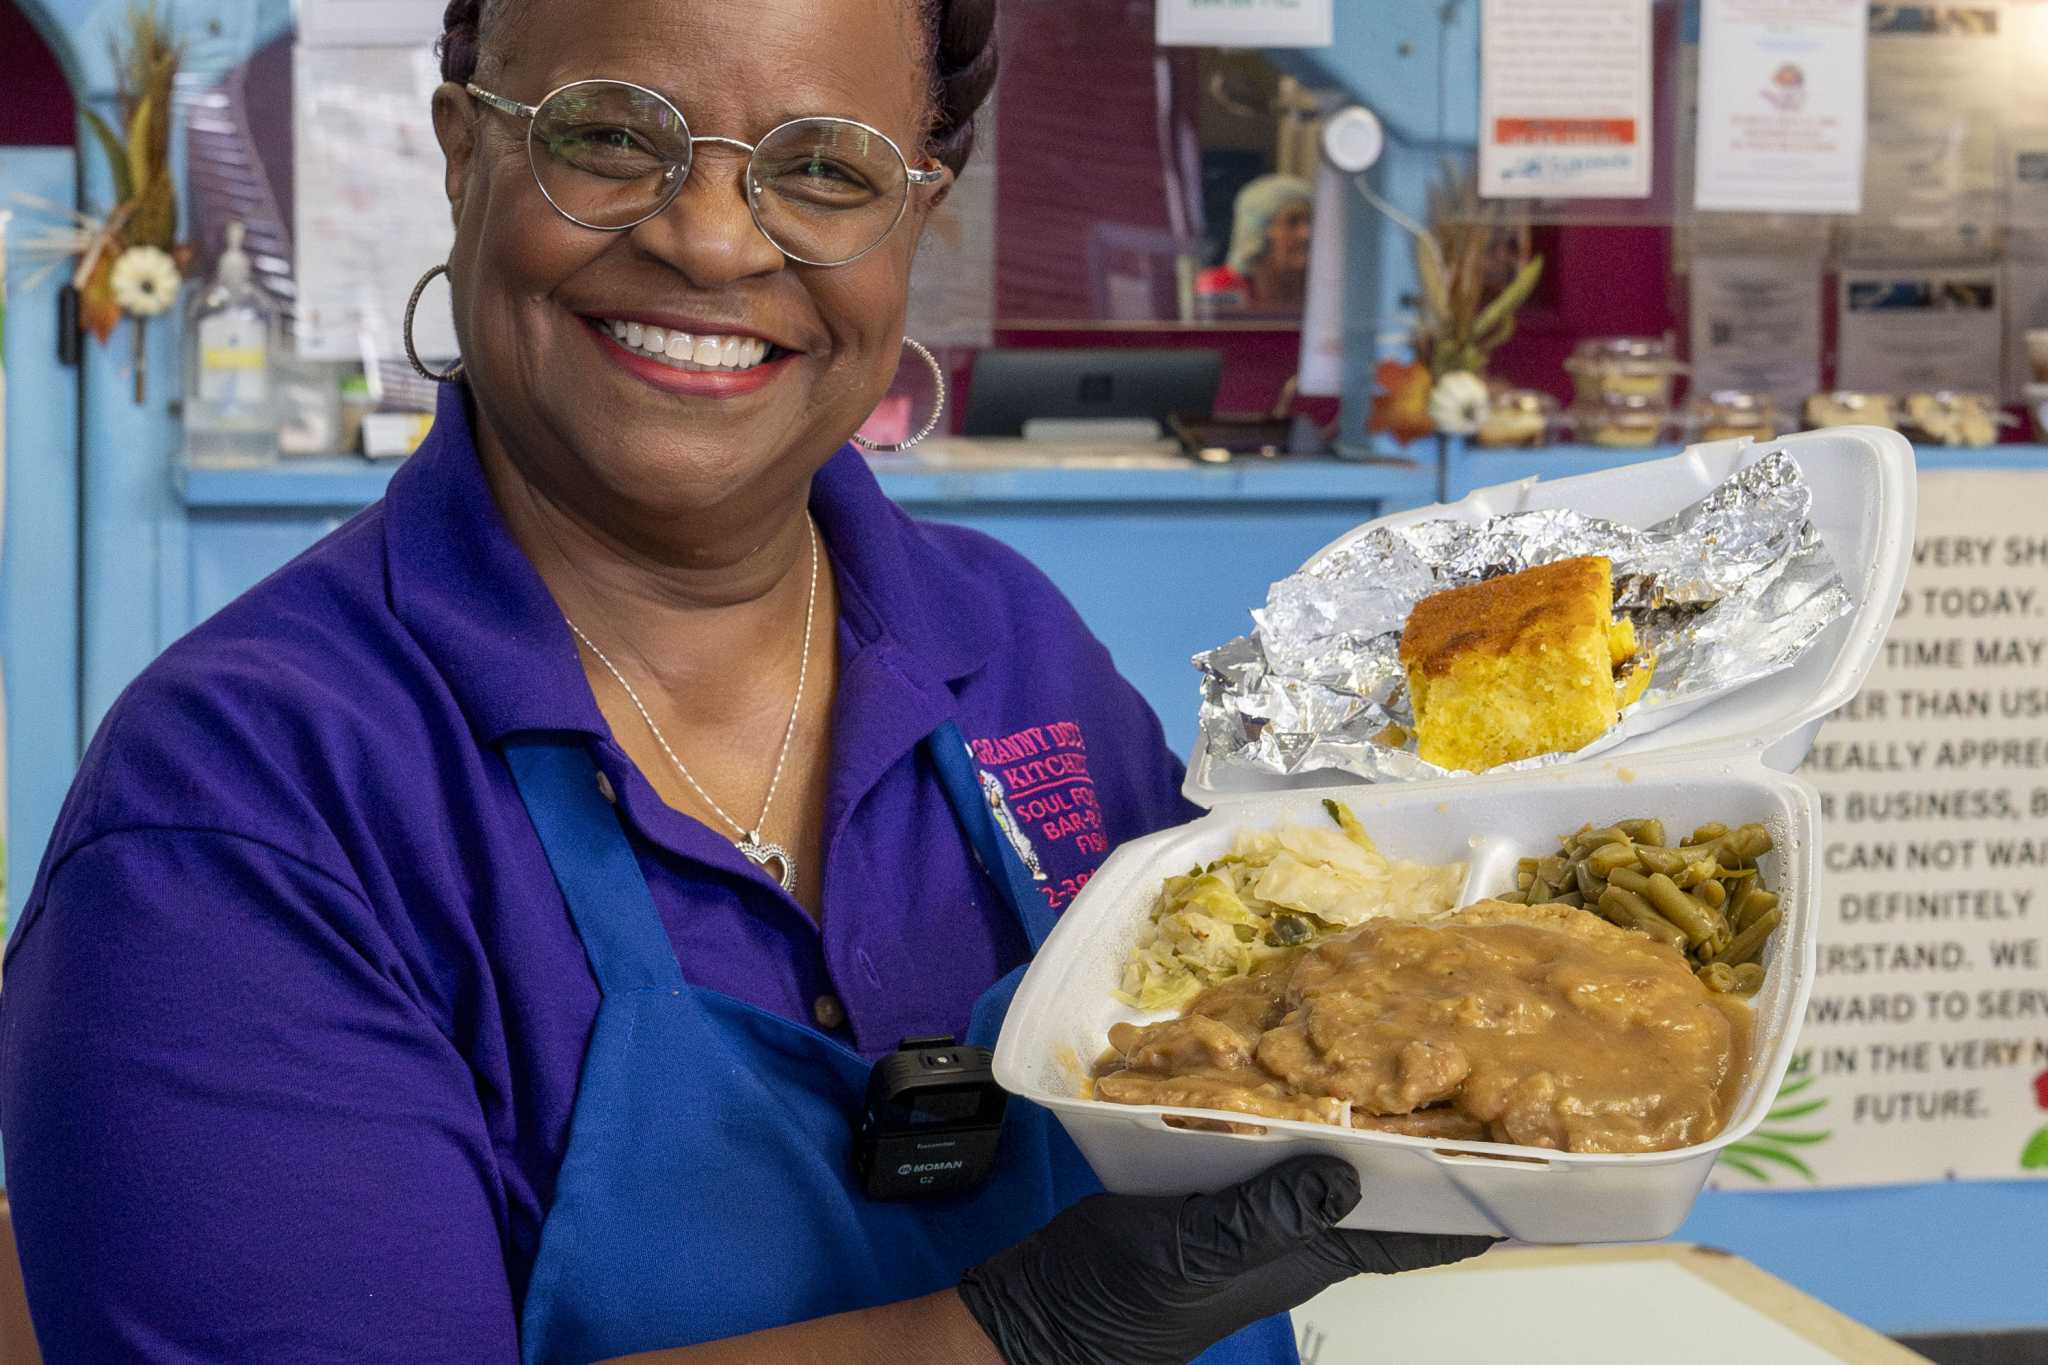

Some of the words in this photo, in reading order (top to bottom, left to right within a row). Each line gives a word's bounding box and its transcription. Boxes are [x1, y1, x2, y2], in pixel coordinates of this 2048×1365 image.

[1923, 586, 2044, 618] TODAY.
[1886, 638, 1963, 670] TIME
[1974, 636, 2045, 668] MAY
[1900, 688, 1989, 719] THAN
[1936, 737, 2048, 770] APPRE
[1016, 792, 1073, 823] SOUL
[1845, 787, 2021, 824] BUSINESS,
[1824, 840, 1896, 873] CAN
[1906, 839, 1976, 871] NOT
[1838, 889, 2033, 924] DEFINITELY
[1988, 938, 2040, 970] WE
[1928, 990, 1970, 1022] TO
[1822, 1046, 1857, 1075] IN
[1868, 1042, 1930, 1073] THE
[1940, 1038, 2024, 1070] VERY
[1852, 1087, 1988, 1123] FUTURE.
[913, 1160, 963, 1173] MOMAN
